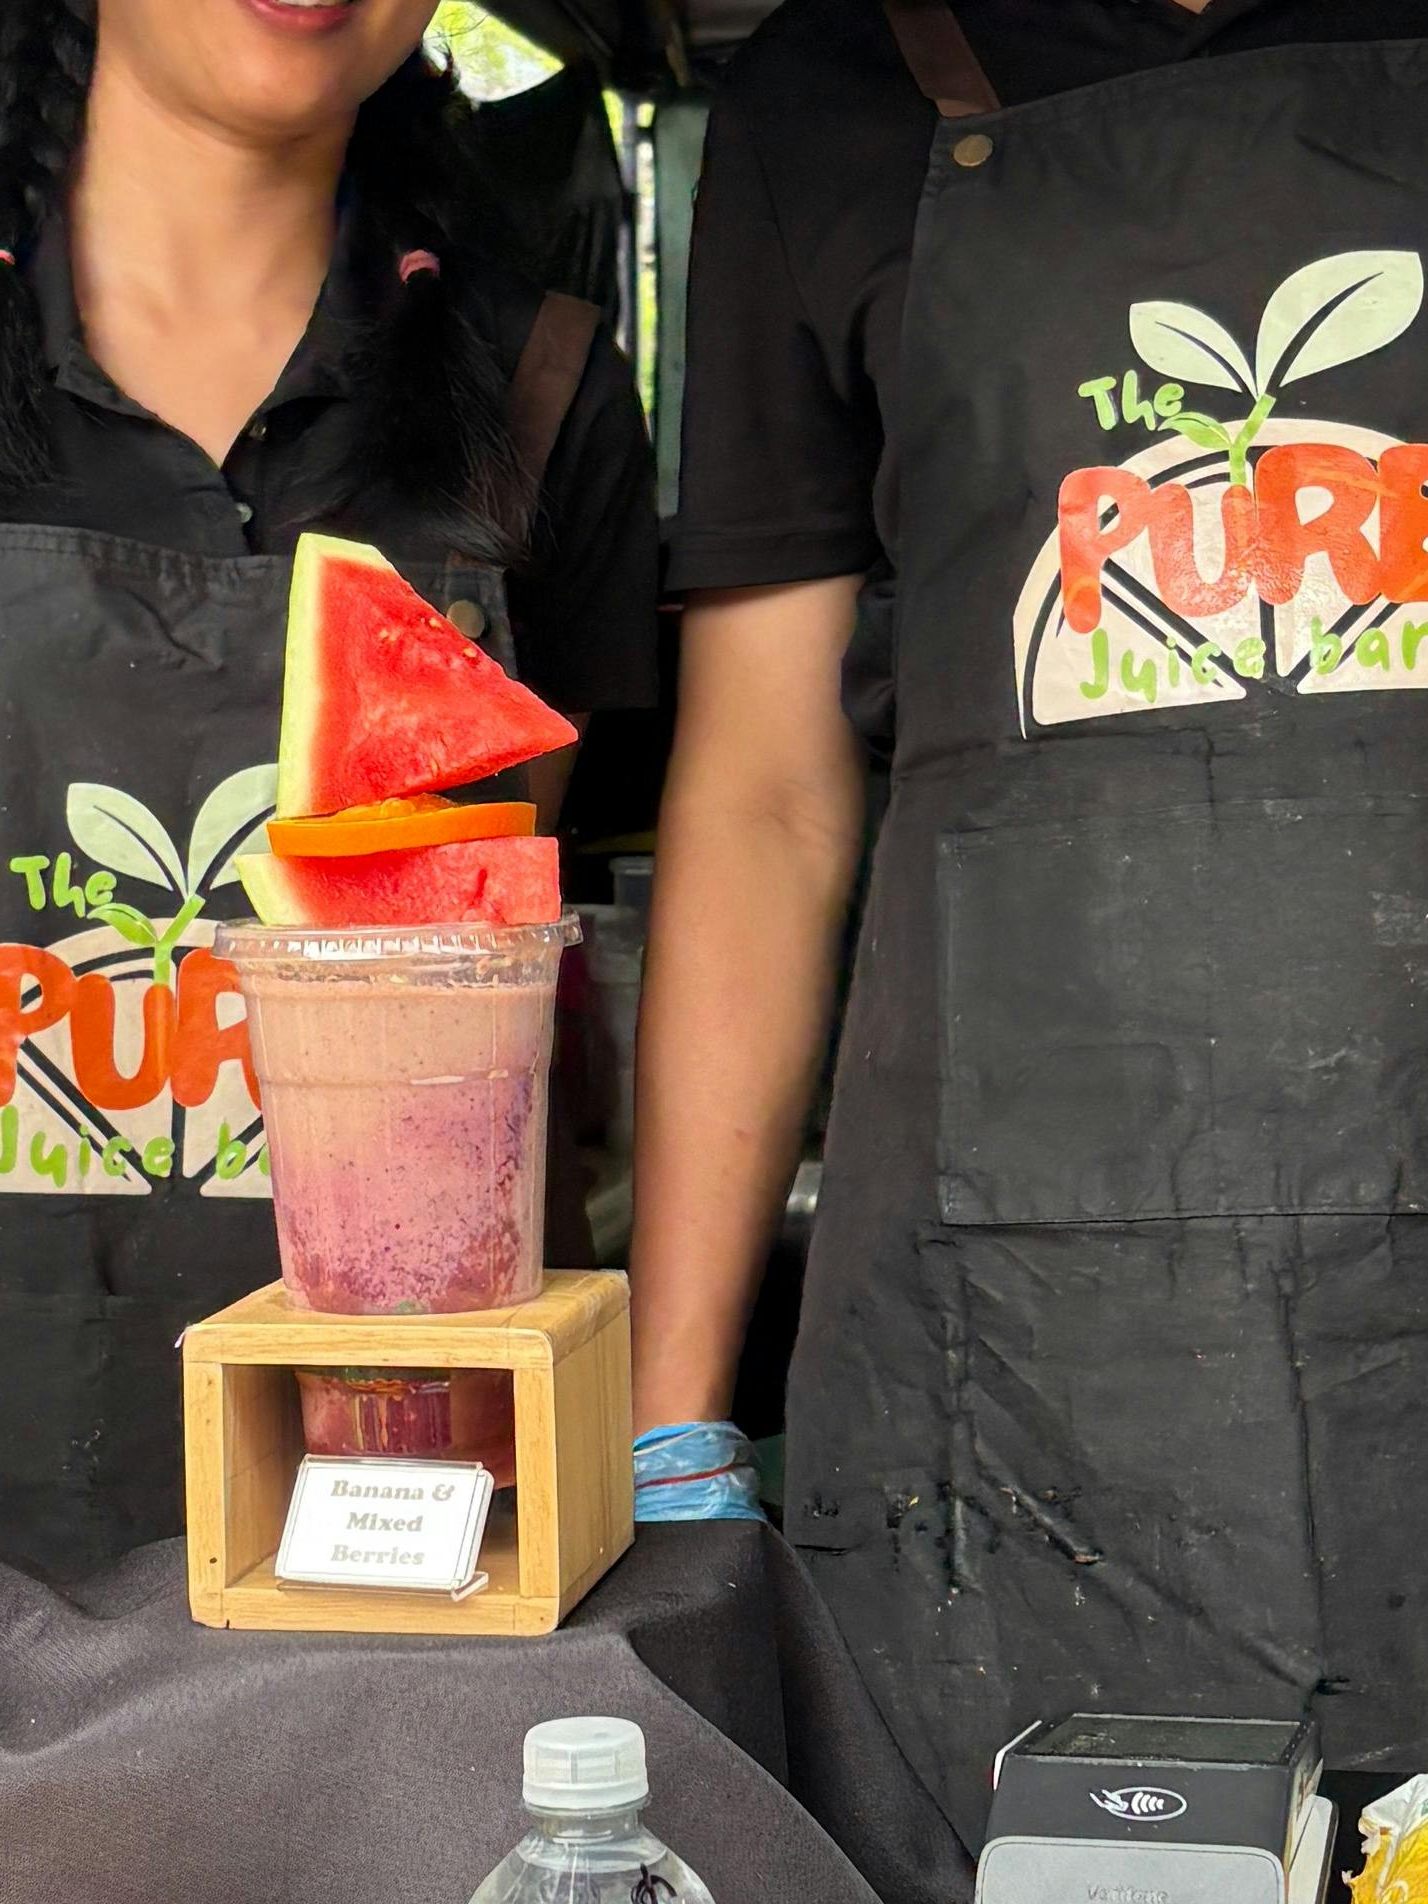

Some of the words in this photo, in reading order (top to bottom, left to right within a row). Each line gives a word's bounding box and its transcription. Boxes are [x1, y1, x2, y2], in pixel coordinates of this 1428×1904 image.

[1078, 369, 1185, 431] The
[1079, 627, 1267, 704] Juice
[9, 852, 118, 918] The
[330, 1479, 424, 1502] Banana
[431, 1483, 456, 1502] &
[345, 1511, 424, 1533] Mixed
[330, 1544, 424, 1566] Berries
